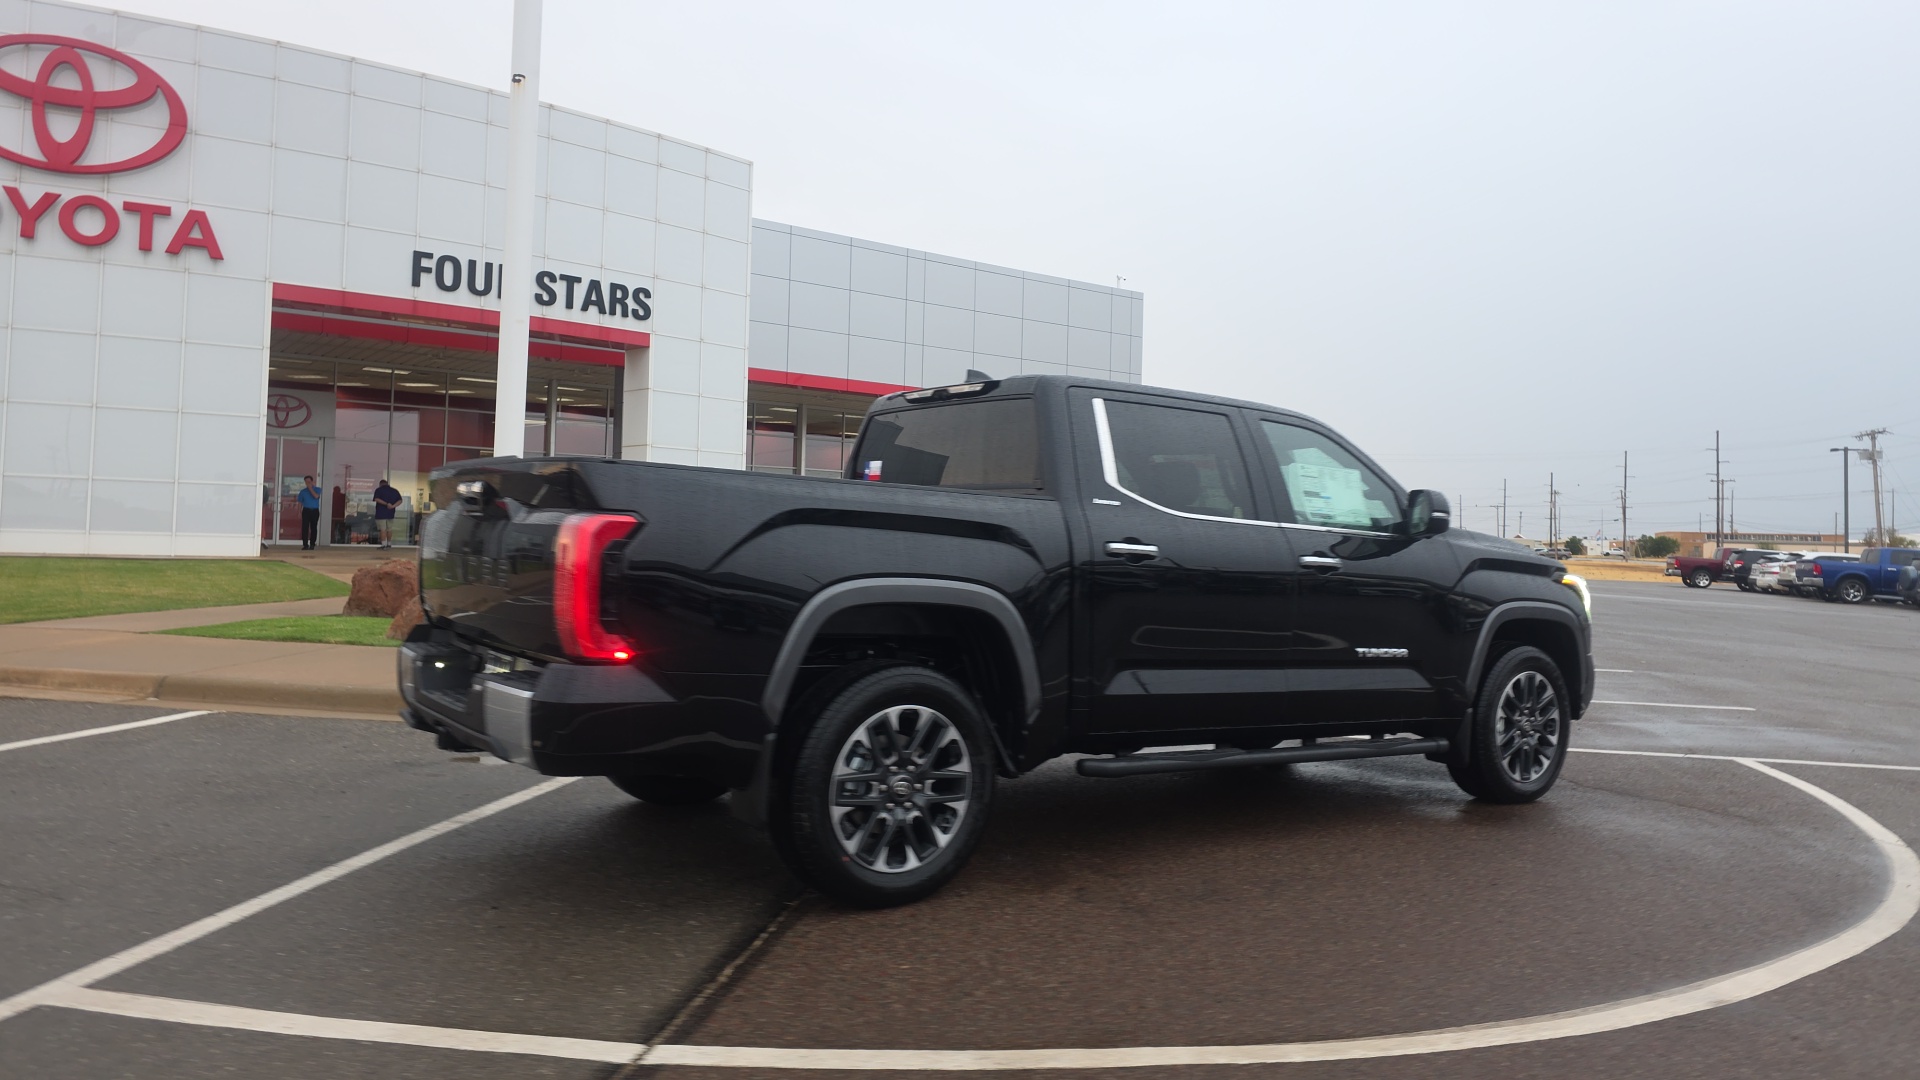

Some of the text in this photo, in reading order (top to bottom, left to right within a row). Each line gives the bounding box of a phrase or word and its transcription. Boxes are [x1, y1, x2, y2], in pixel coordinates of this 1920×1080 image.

[0, 185, 224, 260] YOTA
[534, 270, 652, 321] STARS
[1354, 647, 1409, 658] TUNDRA
